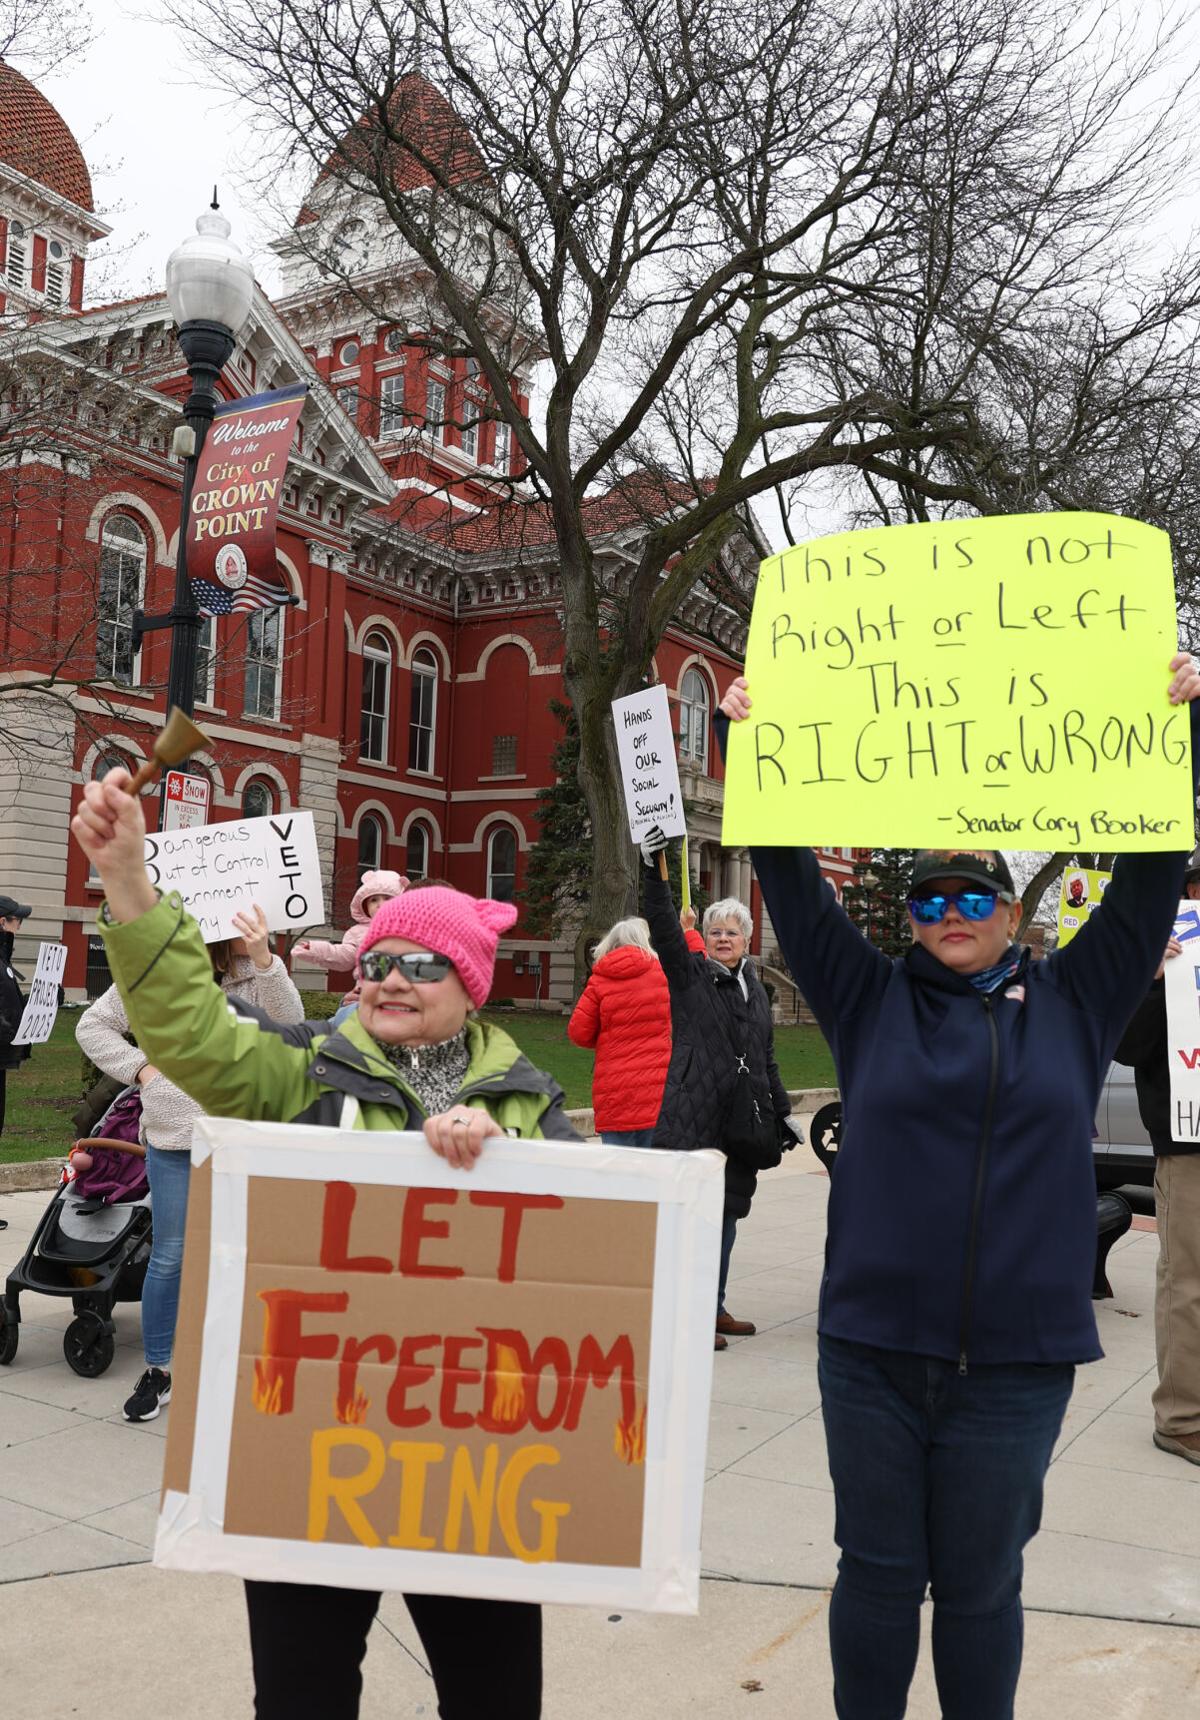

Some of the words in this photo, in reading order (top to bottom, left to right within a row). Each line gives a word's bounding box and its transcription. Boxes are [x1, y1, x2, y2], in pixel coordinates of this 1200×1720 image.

[213, 417, 290, 446] Welcome
[230, 445, 241, 456] to
[243, 441, 260, 454] the
[206, 462, 247, 483] City
[251, 452, 276, 474] of
[192, 478, 280, 514] CROWN
[194, 506, 269, 542] POINT
[766, 546, 887, 593] This
[932, 536, 974, 570] is
[1026, 530, 1138, 566] not
[771, 604, 905, 670] Right
[933, 611, 972, 636] or
[858, 661, 961, 714] This
[1008, 667, 1049, 707] is
[623, 708, 653, 729] HANDS
[633, 733, 648, 750] OFF
[755, 720, 976, 792] RIGHT
[985, 750, 1012, 774] or
[635, 752, 662, 770] OUR
[184, 784, 206, 799] SNOW
[175, 804, 180, 812] IN
[181, 805, 199, 815] EXCESS
[179, 813, 186, 821] OF
[1033, 806, 1081, 846] Cory
[1091, 810, 1181, 835] Booker
[191, 857, 208, 880] of
[214, 848, 270, 874] Control
[269, 818, 309, 919] VETO
[1063, 917, 1078, 927] RED
[41, 944, 63, 971] VETO
[22, 1012, 53, 1039] 2025
[320, 1180, 565, 1283] LET
[307, 1427, 571, 1564] RING
